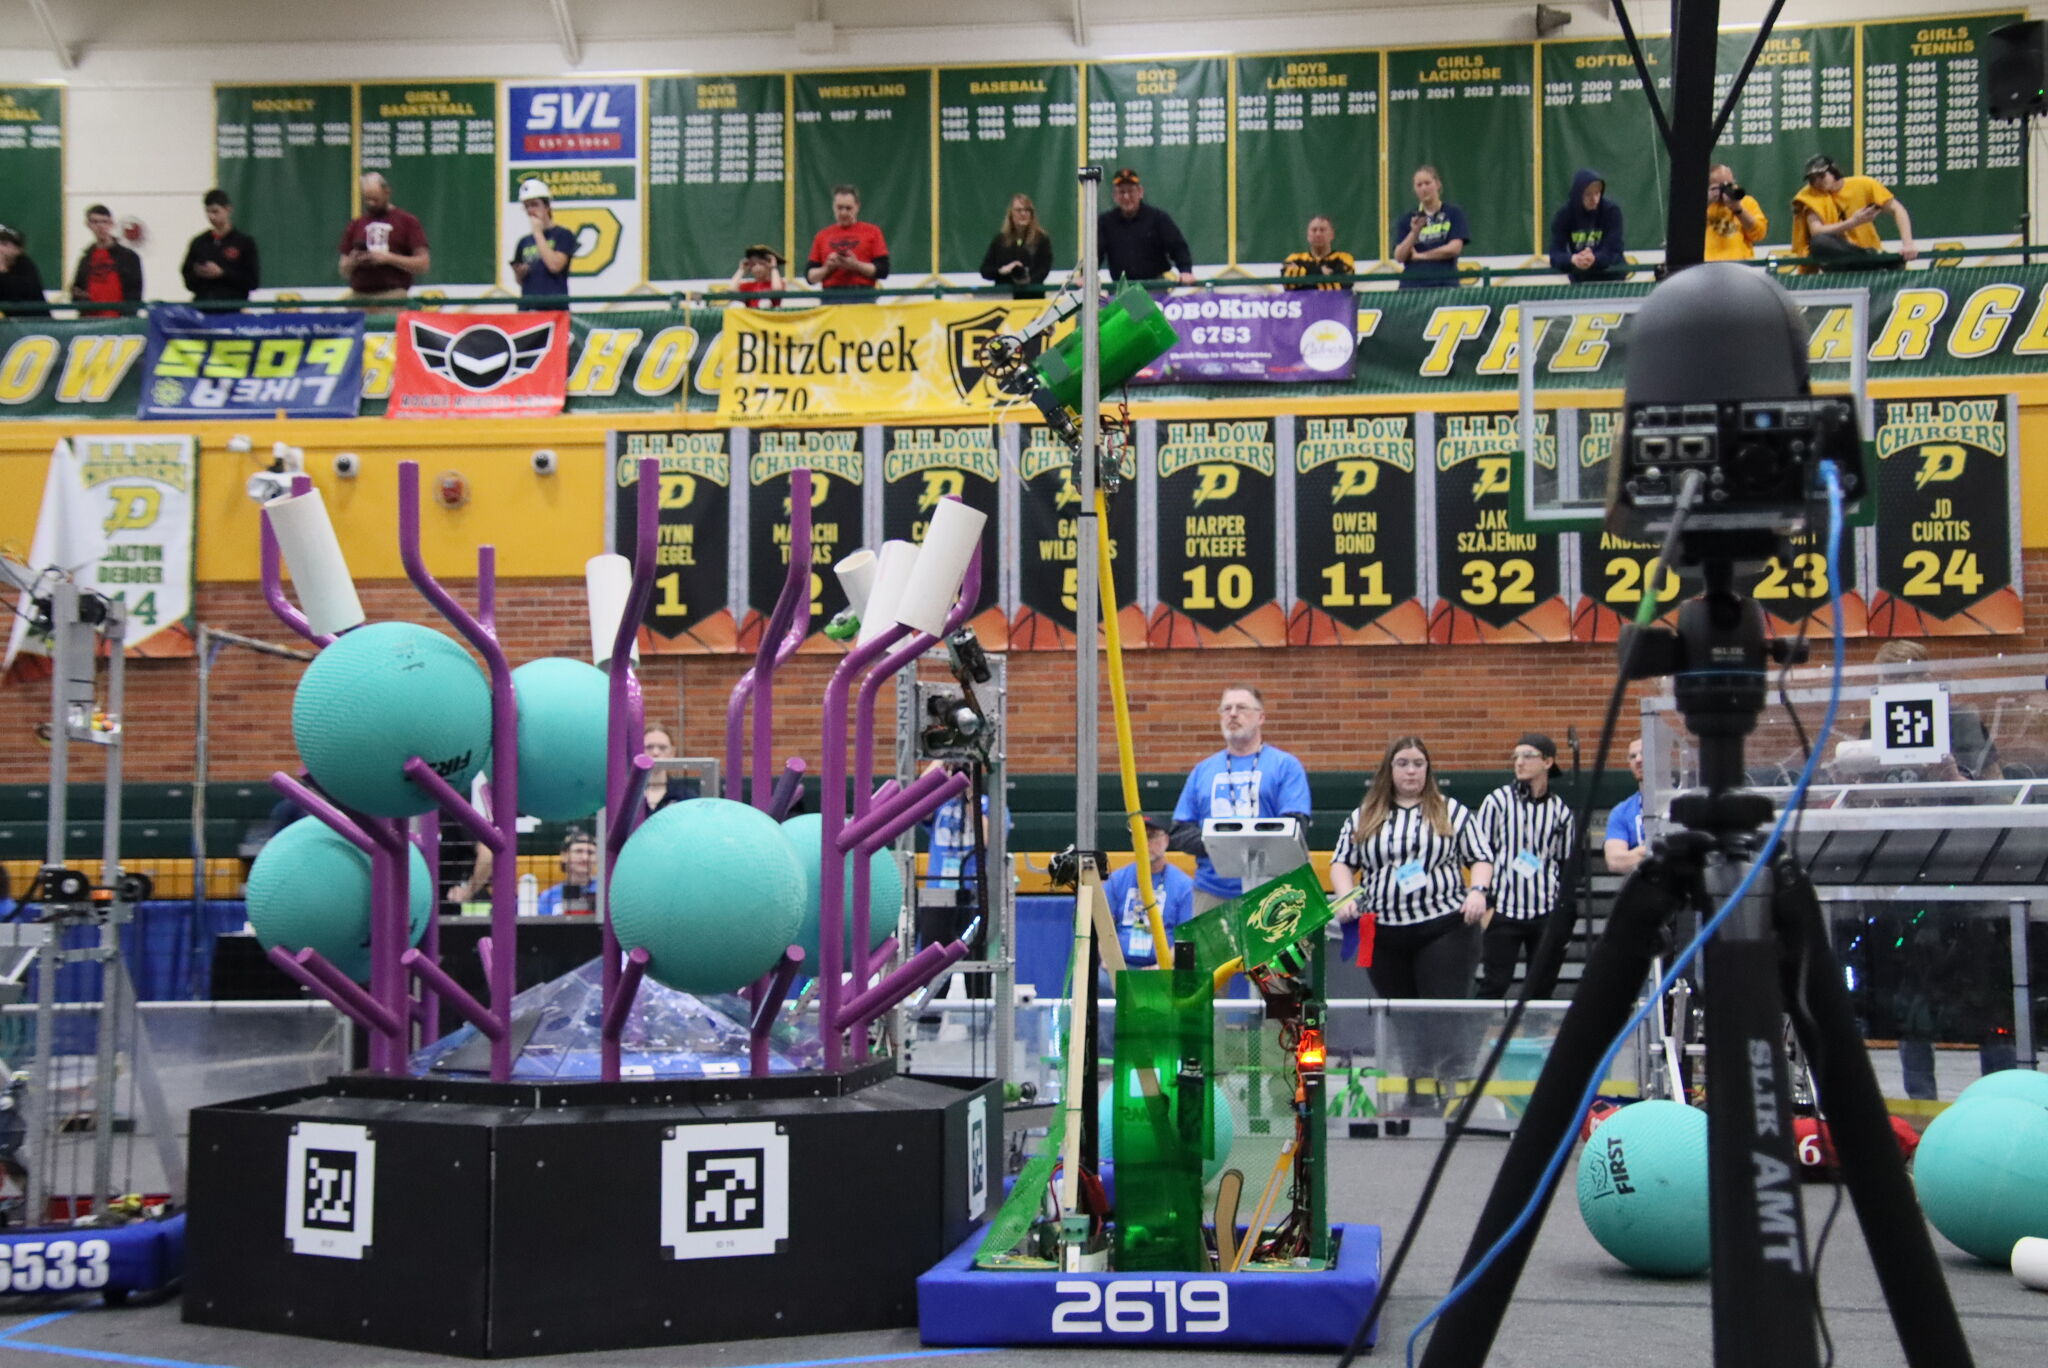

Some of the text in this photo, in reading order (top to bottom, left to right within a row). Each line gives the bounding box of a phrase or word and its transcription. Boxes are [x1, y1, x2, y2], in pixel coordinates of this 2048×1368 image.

[1916, 27, 1968, 42] GIRLS
[1763, 38, 1801, 51] IRLS
[1911, 40, 1974, 56] TENNIS
[1437, 56, 1484, 68] GIRLS
[1576, 53, 1658, 68] SOFTBAL
[1756, 51, 1810, 65] OCCER
[1866, 59, 1978, 76] 1975 1981 1982
[1136, 69, 1177, 81] BOYS
[1287, 63, 1328, 75] BOYS
[1419, 68, 1502, 82] LACROSSE
[1946, 71, 1978, 82] 1987
[697, 84, 736, 96] BOYS
[818, 84, 906, 98] WRESTLING
[970, 80, 1047, 94] BASEBALL
[1136, 82, 1177, 95] GOLF
[1266, 74, 1347, 89] LACROSSE
[1905, 86, 1937, 97] 1991
[1946, 84, 1978, 95] 1992
[1545, 93, 1611, 106] 2007 2024
[1866, 96, 1978, 113] 1994 1995 1997
[526, 92, 620, 130] SVL
[1821, 105, 1850, 116] 2011
[1866, 108, 1978, 125] 1999 2001 2003
[1742, 116, 1851, 132] 2013 2014 2022
[1741, 134, 1772, 145] 2024
[1866, 131, 2021, 150] 2010 2011 2012 2013
[1866, 151, 1897, 162] 2014
[1905, 148, 1937, 159] 2015
[1987, 144, 2021, 155] 2017
[1905, 161, 1937, 172] 2019
[1946, 158, 1978, 169] 2021
[1987, 157, 2021, 168] 2022
[542, 171, 602, 183] LEAGUE
[1905, 173, 1937, 184] 2024
[549, 184, 617, 196] AMPIONS
[1192, 326, 1251, 344] 6753
[1420, 305, 1623, 377] THE
[737, 326, 918, 376] BlitzCreek
[734, 386, 807, 412] 3770
[1890, 402, 1996, 424] H.H. DOW
[1171, 424, 1267, 444] H.H. DOW
[1309, 419, 1406, 440] H.H. DOW
[1450, 416, 1493, 436] H.H.
[675, 436, 722, 454] DOW
[809, 432, 856, 453] DOW
[897, 431, 992, 450] H.H. DOW
[1878, 424, 2005, 458] CHARGERS
[887, 450, 998, 482] CHARGERS
[1161, 445, 1274, 477] CHARGERS
[1299, 441, 1413, 473] CHARGERS
[752, 453, 862, 485] CHARGERS
[1930, 498, 1952, 520] JD
[1186, 516, 1245, 536] HARPER
[1333, 512, 1377, 532] OWEN
[1912, 520, 1970, 543] CURTIS
[1185, 537, 1246, 557] O'KEEFE
[1335, 534, 1375, 555] BOND
[1461, 559, 1535, 605] 32
[1605, 556, 1681, 603] 20
[1752, 553, 1829, 599] 23
[1903, 549, 1984, 597] 24
[1183, 564, 1253, 609] 10
[1322, 561, 1392, 607] 11
[655, 572, 687, 616] 1
[1748, 1039, 1802, 1273] SLIK AMT
[1798, 1134, 1822, 1167] 6
[1607, 1137, 1636, 1195] FIRST
[1052, 1279, 1229, 1333] 2619
